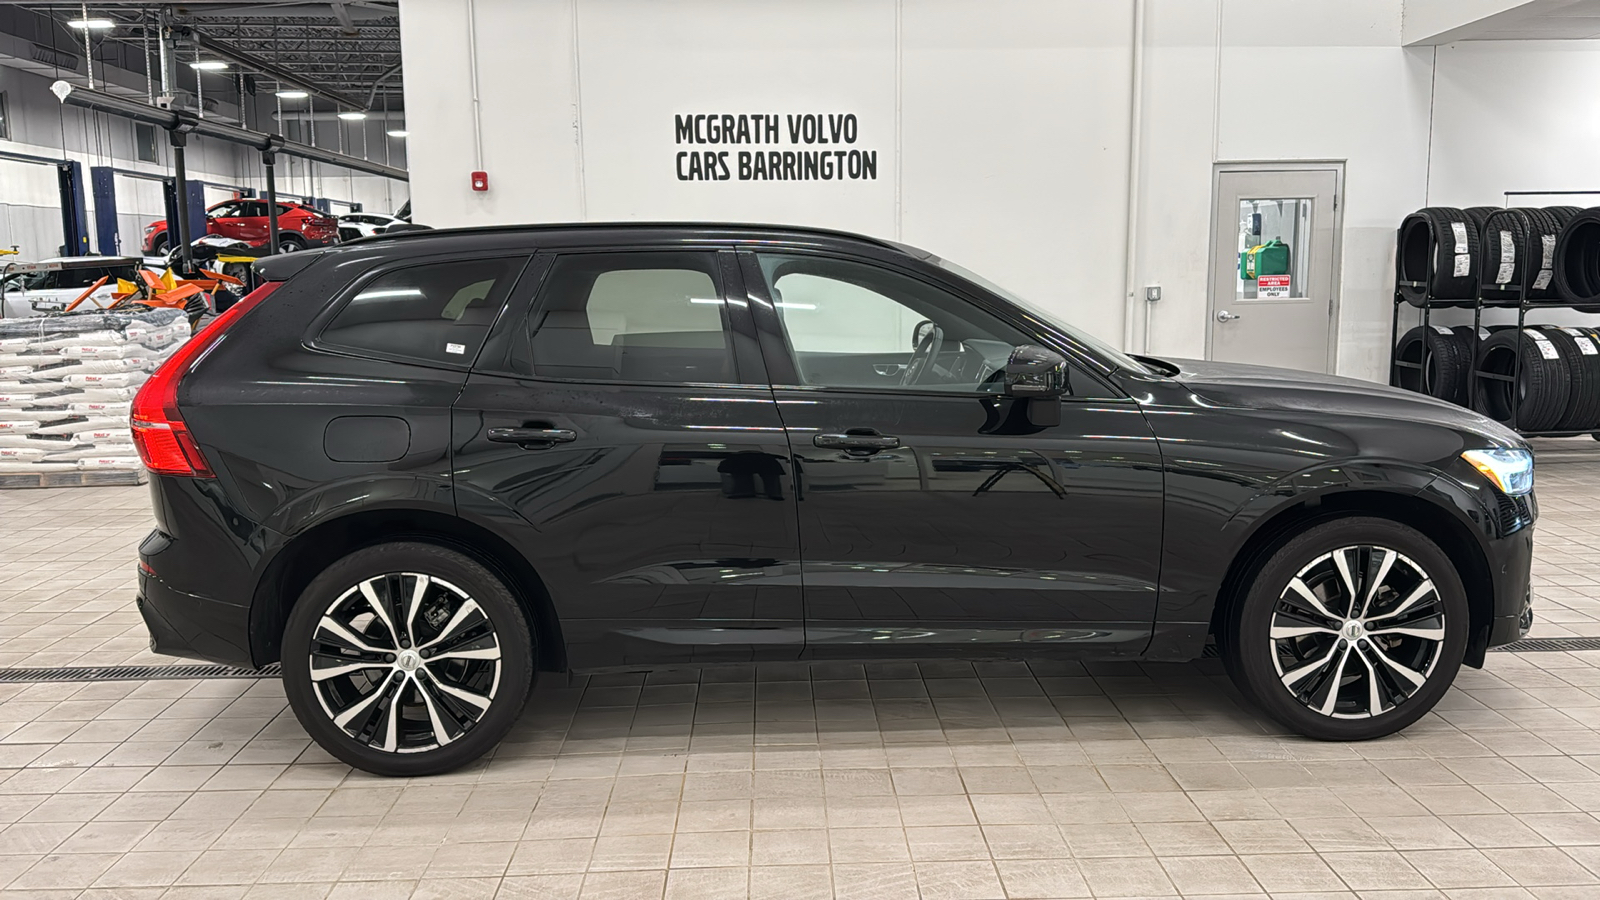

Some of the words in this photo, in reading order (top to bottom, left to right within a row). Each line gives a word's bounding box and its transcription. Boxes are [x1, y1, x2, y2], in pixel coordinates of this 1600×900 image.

[674, 114, 779, 144] MCGRATH
[787, 113, 858, 144] VOLVO
[676, 151, 730, 181] CARS
[738, 149, 877, 181] BARRINGTON
